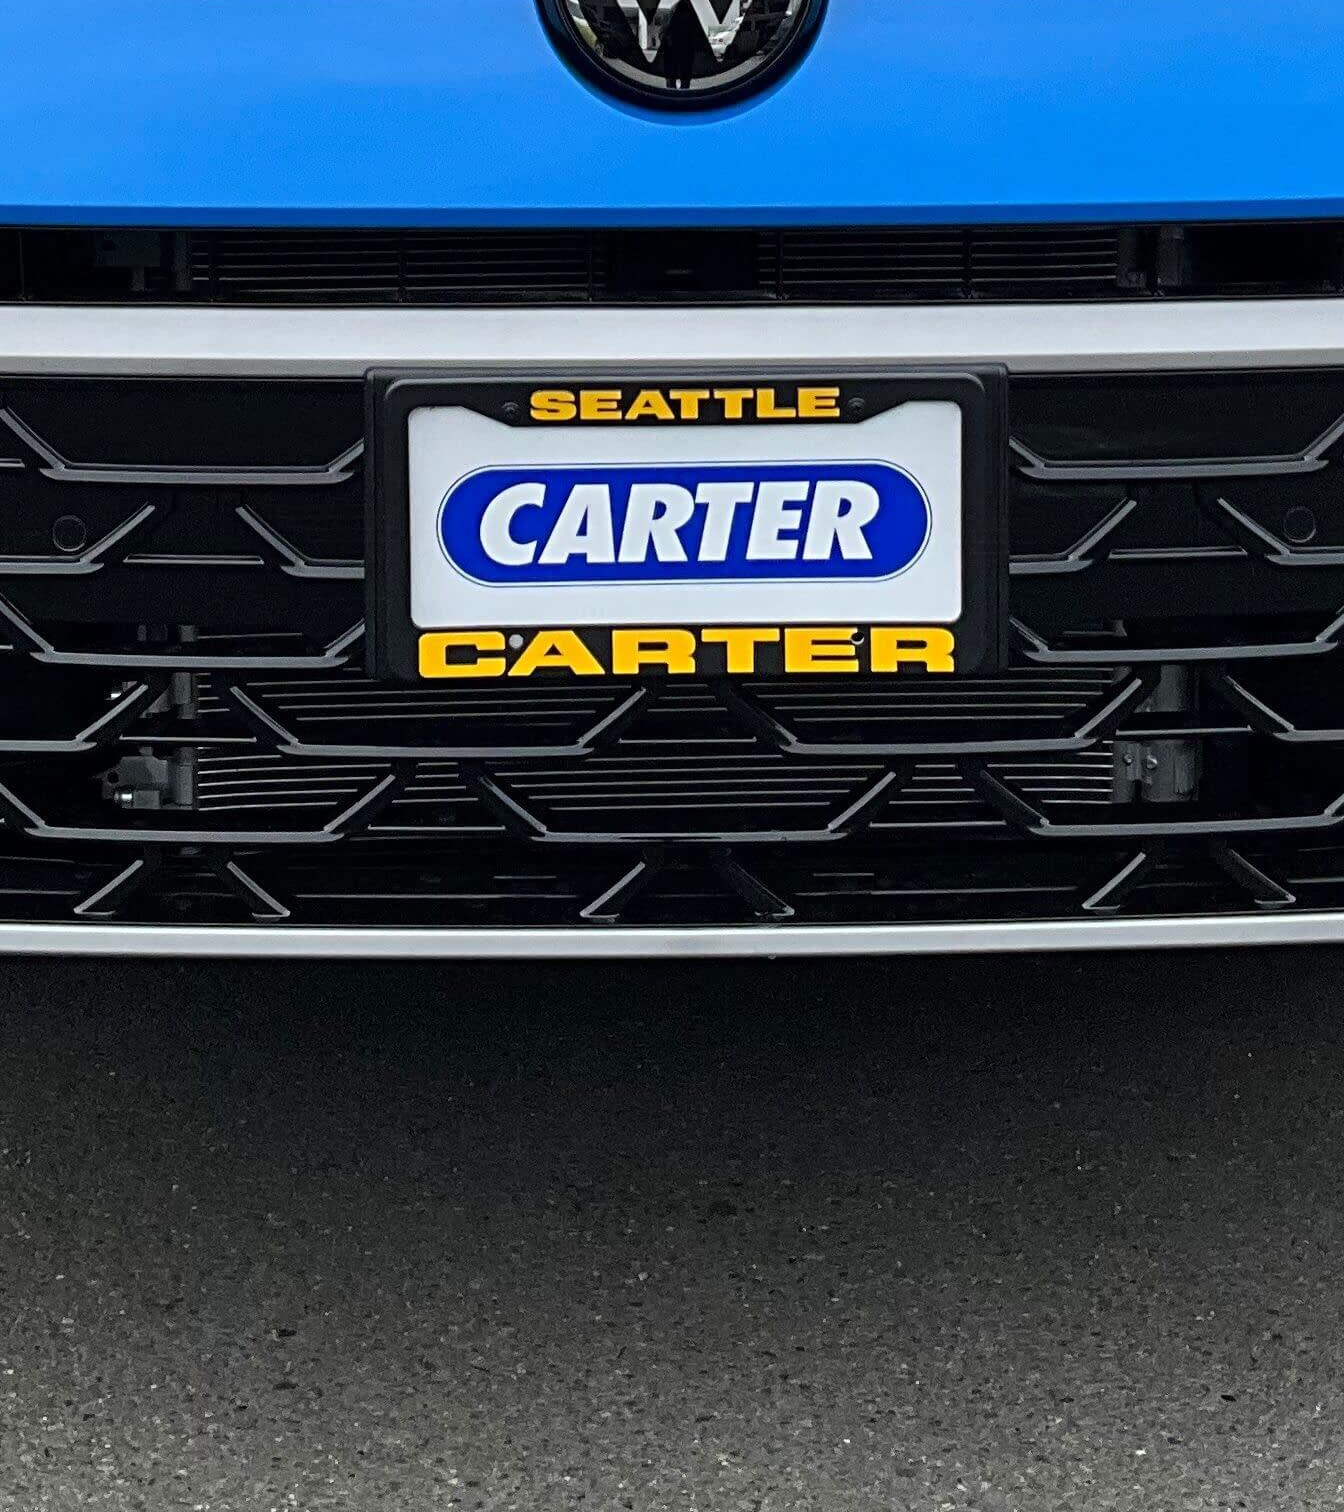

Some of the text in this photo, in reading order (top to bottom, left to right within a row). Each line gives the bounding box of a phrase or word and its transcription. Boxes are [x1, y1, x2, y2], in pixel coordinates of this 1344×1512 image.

[530, 387, 840, 421] SEATTLE
[479, 480, 880, 566] CARTER
[418, 626, 956, 679] CARTER
